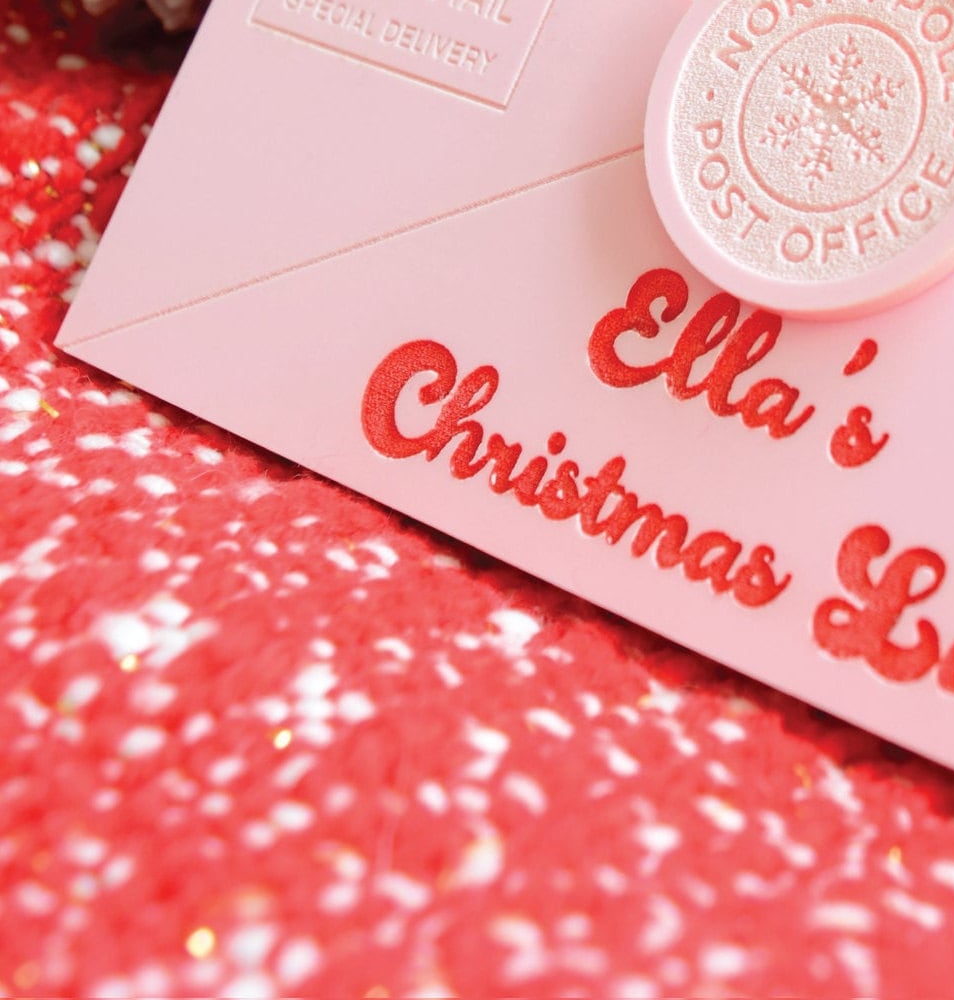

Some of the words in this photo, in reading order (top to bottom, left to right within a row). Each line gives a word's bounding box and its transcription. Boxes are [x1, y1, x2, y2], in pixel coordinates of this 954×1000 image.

[380, 18, 498, 75] DELIVERY
[695, 119, 769, 240] POST
[361, 339, 792, 608] Christmas
